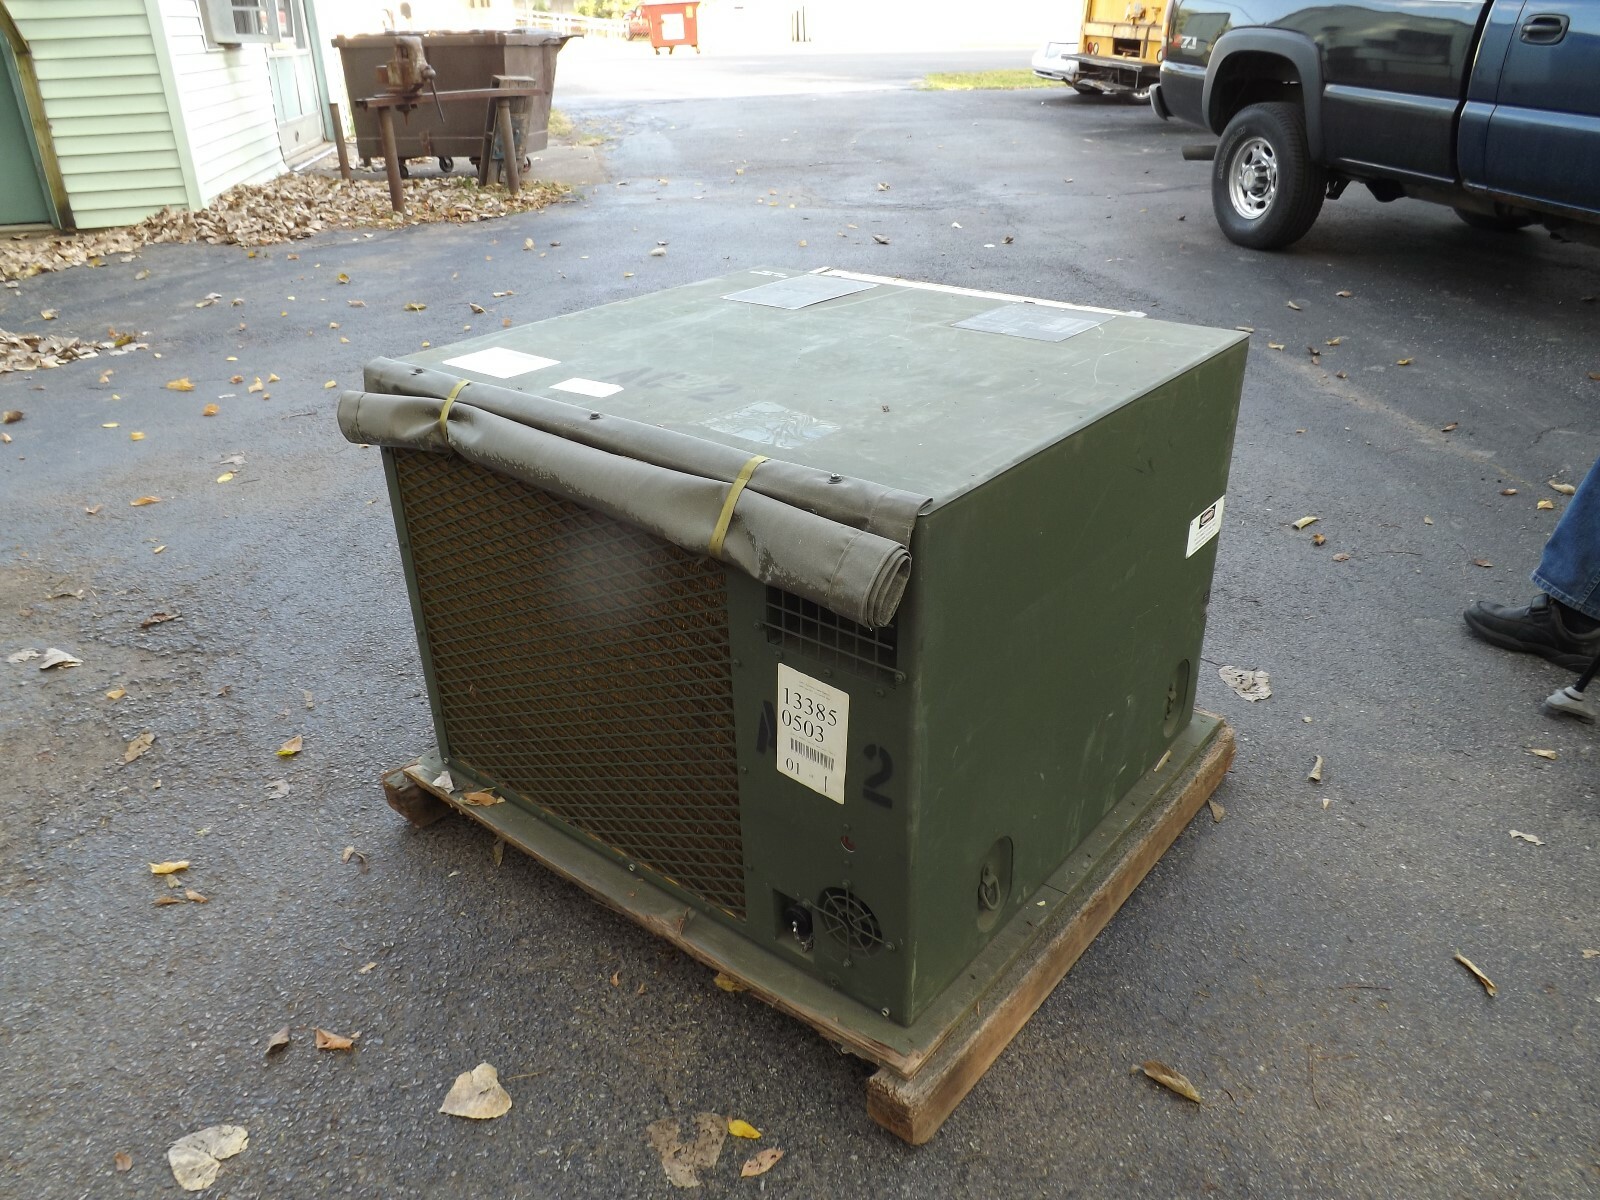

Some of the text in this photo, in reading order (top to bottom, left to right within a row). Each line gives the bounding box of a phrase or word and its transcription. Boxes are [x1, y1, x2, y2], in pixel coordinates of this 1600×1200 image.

[783, 687, 838, 727] 13385
[781, 709, 825, 743] 0503
[785, 757, 801, 775] 01
[862, 743, 894, 810] 2
